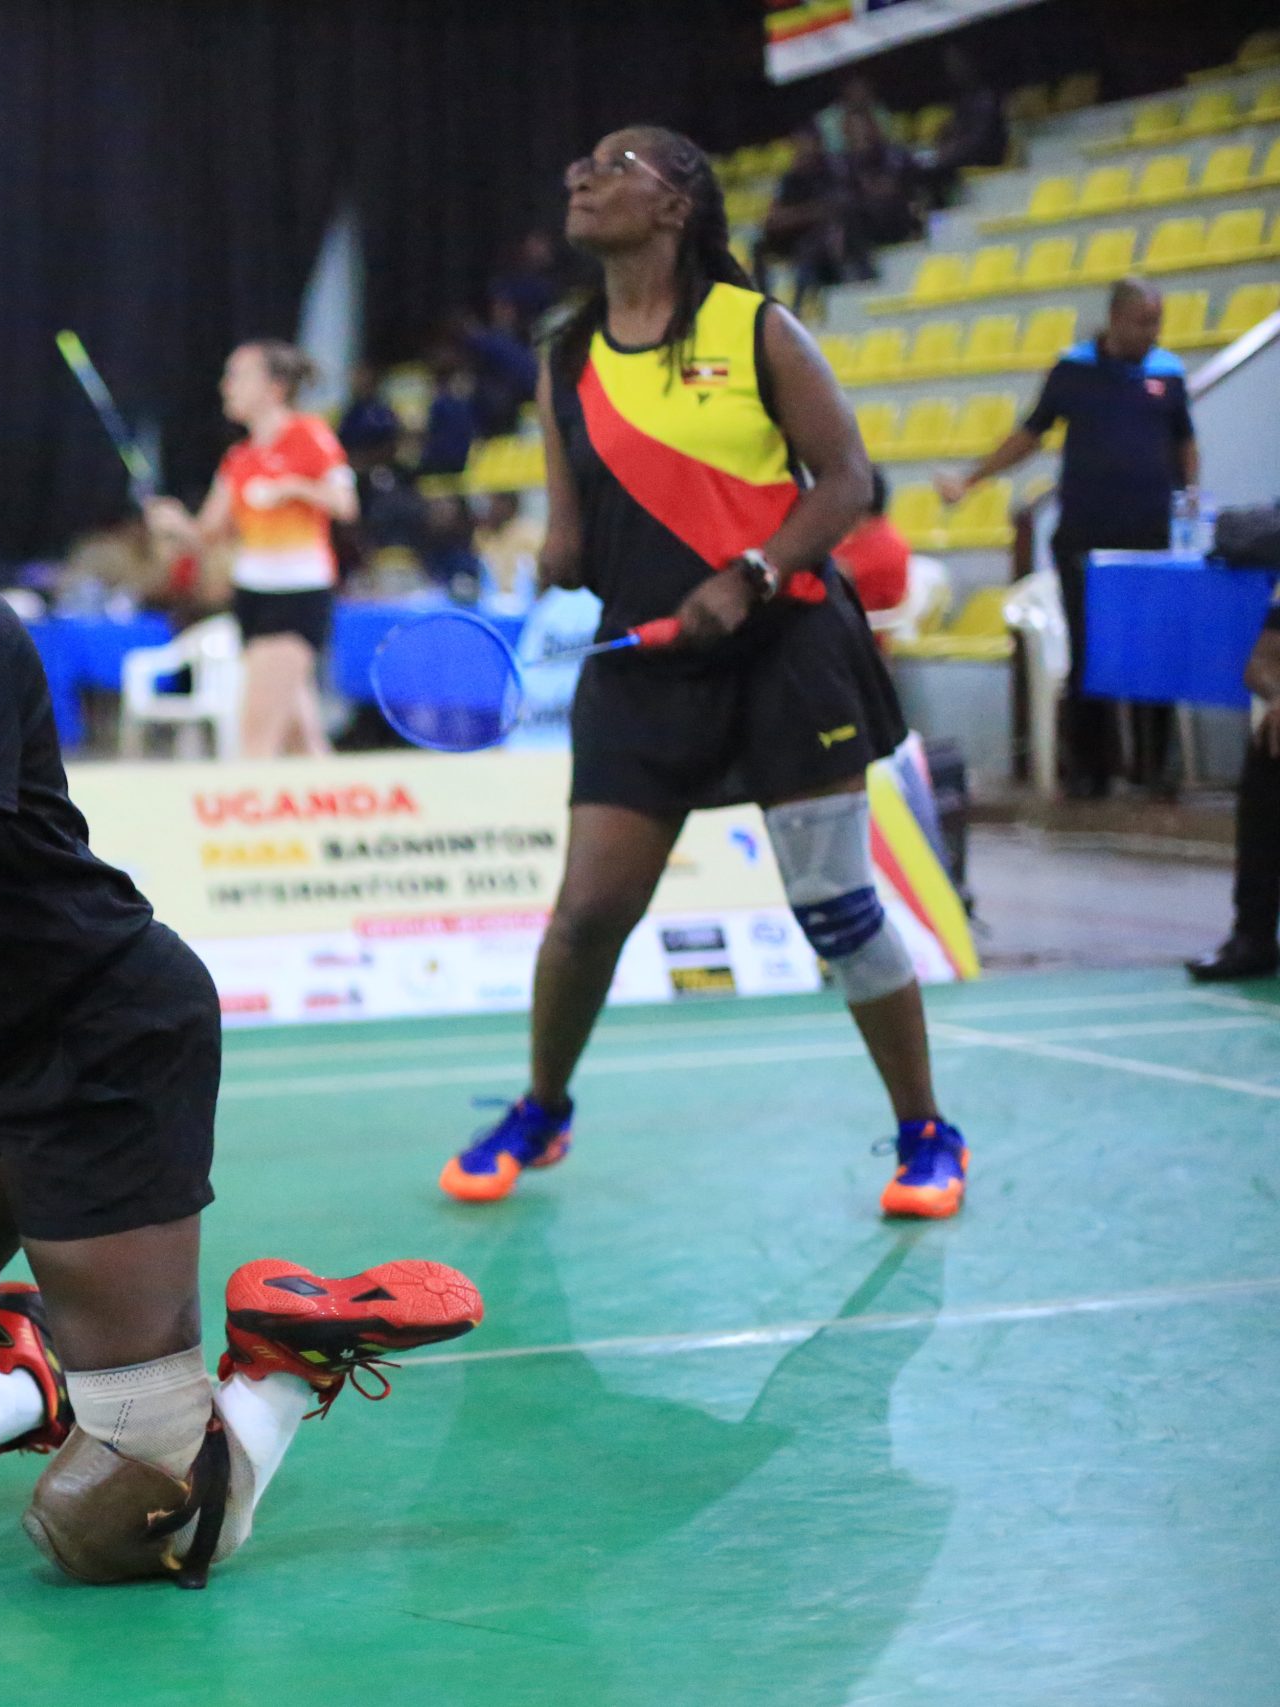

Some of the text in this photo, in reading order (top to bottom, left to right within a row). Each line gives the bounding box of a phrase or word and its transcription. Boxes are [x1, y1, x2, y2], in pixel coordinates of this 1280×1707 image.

[194, 785, 420, 828] UGANDA
[202, 828, 557, 869] PARA BADMINTON
